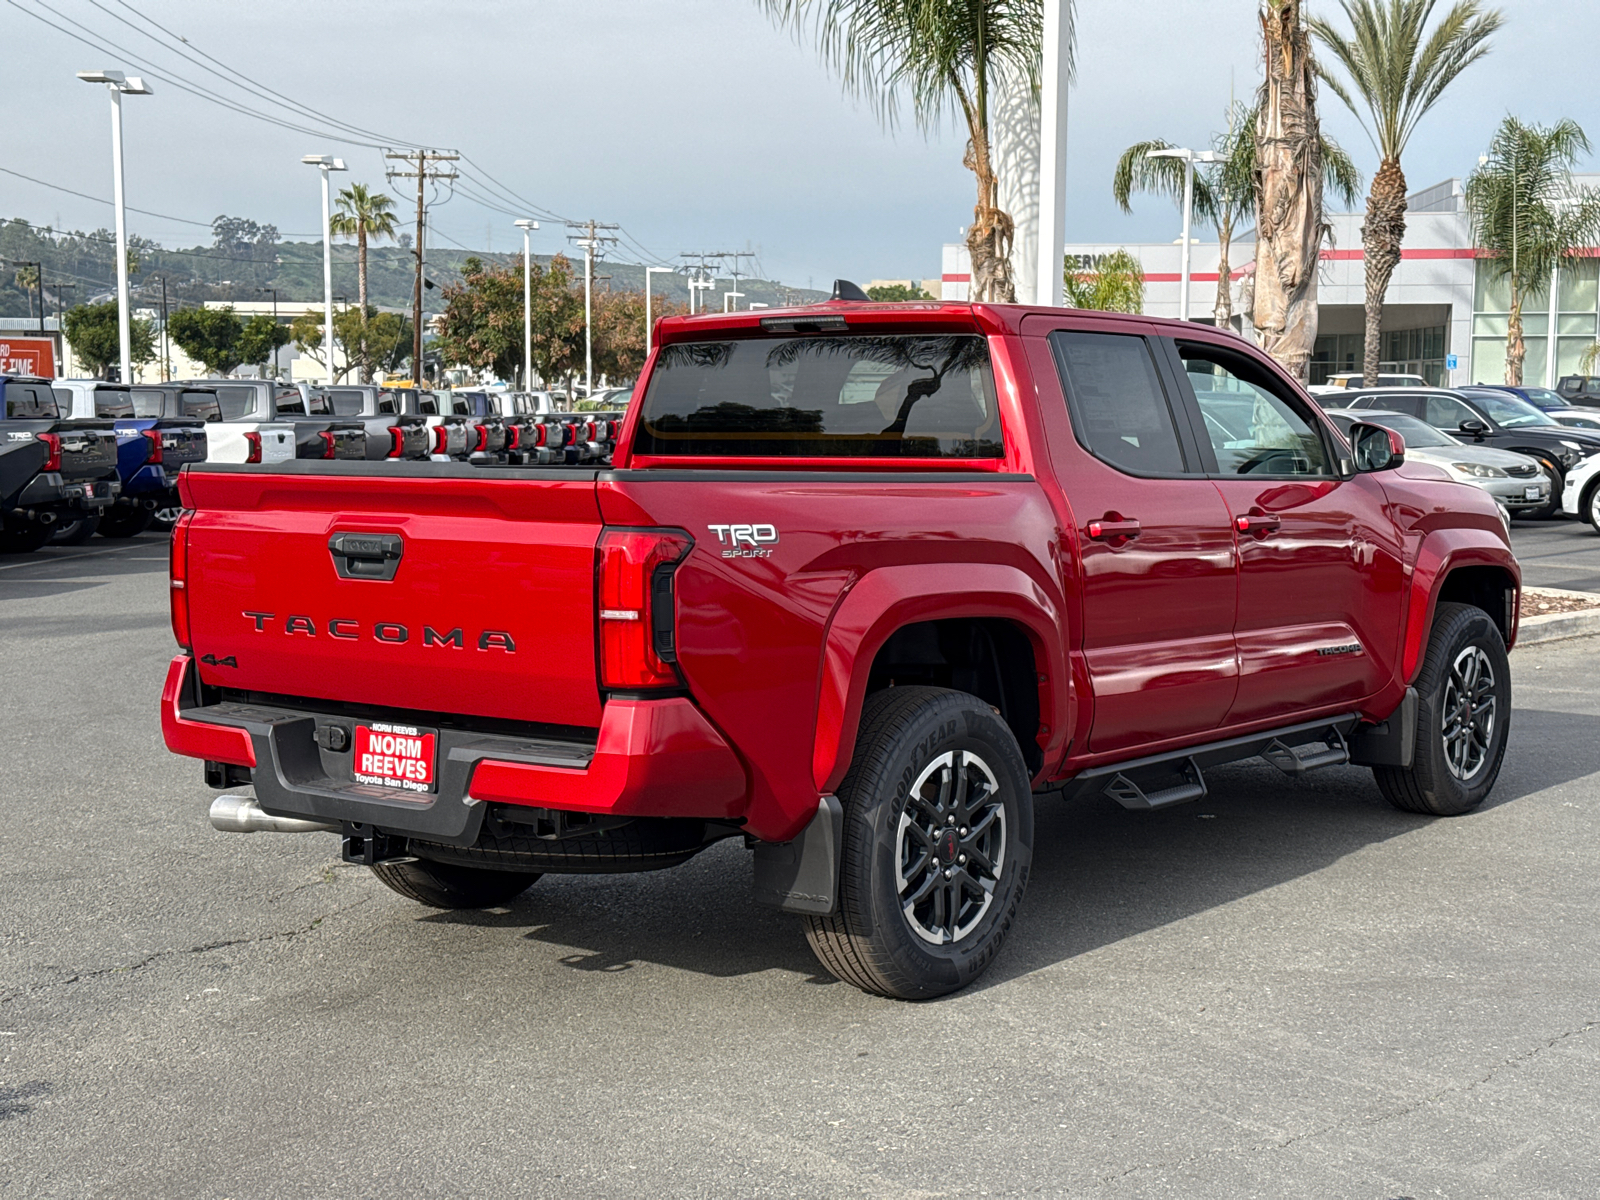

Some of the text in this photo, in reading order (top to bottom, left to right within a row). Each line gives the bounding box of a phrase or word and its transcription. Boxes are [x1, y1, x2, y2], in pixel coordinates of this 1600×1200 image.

[7, 431, 32, 439] TRD
[707, 523, 780, 548] TRD
[346, 540, 380, 552] TOYOTA
[721, 549, 773, 559] SPORT
[241, 610, 517, 655] TACOMA
[1315, 643, 1363, 656] TACOMA
[372, 723, 418, 736] NORM REEVES
[362, 734, 427, 780] NORM REEVES
[354, 772, 429, 792] Toyota San Diego
